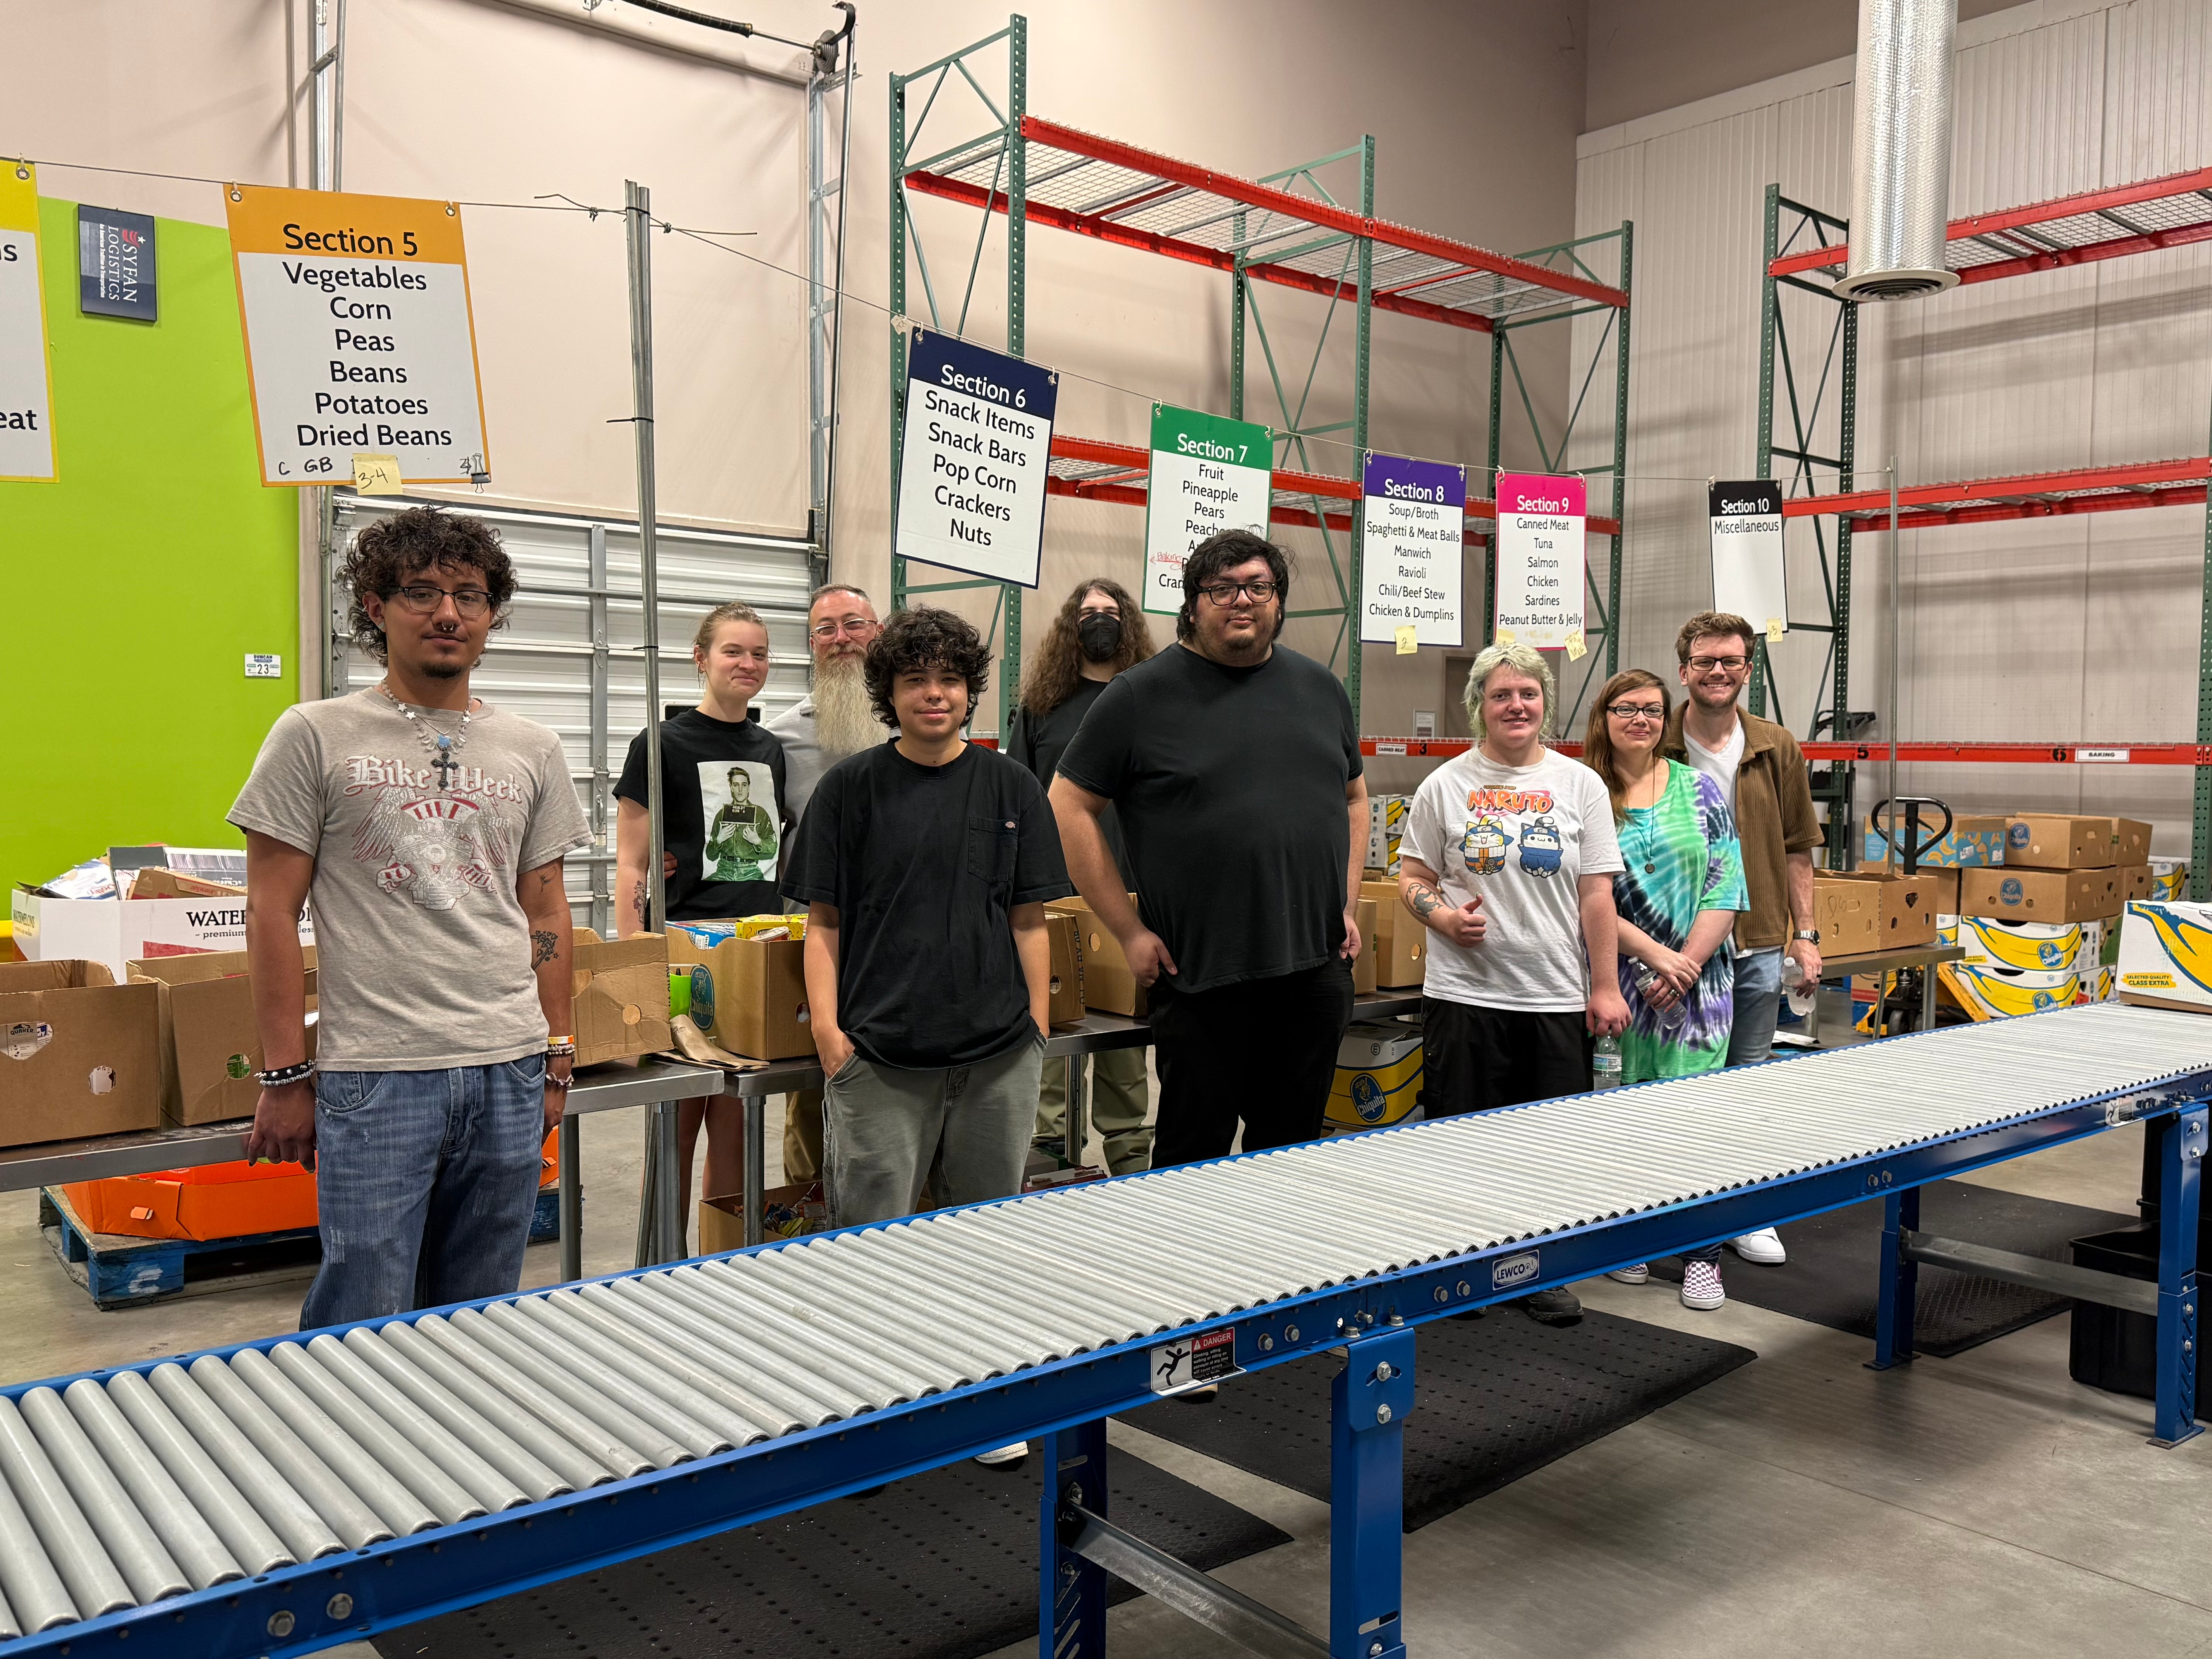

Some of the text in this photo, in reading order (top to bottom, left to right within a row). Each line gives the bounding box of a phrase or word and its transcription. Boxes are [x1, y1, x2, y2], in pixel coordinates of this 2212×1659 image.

[283, 224, 417, 256] Section 5
[108, 225, 119, 301] LOGISTICS
[122, 244, 137, 303] SYFAN
[282, 262, 426, 292] Vegetables
[330, 297, 391, 319] Corn
[335, 329, 394, 351] Peas
[330, 361, 407, 383] Beans
[941, 364, 1025, 407] Section 6
[315, 393, 428, 414] Potatoes
[926, 390, 1034, 439] Snack Items
[297, 423, 451, 446] Dried Beans
[929, 422, 1025, 466] Snack Bars
[1178, 433, 1247, 462] Section 7
[359, 467, 388, 489] 3-4
[934, 453, 1016, 493] Pop Corn
[1199, 464, 1224, 480] Fruit
[1183, 481, 1238, 503] Pineapple
[1385, 479, 1444, 502] Section 8
[935, 485, 1010, 521] Crackers
[1195, 502, 1224, 518] Pears
[1389, 503, 1438, 520] Soup/Broth
[1518, 495, 1568, 512] Section 9
[1722, 498, 1769, 514] Section 10
[951, 519, 991, 545] Nuts
[1367, 521, 1459, 542] Spaghetti & Meat Balls
[1517, 518, 1569, 530] Canned Meat
[1715, 519, 1779, 534] Miscellaneous
[1395, 545, 1431, 559] Manwich
[1534, 538, 1553, 548] Tuna
[1399, 566, 1425, 578] Ravioli
[1528, 556, 1558, 567] Salmon
[1528, 575, 1558, 586] Chicken
[1379, 584, 1444, 599] Chili/Beef Stew
[1525, 595, 1559, 605] Sardines
[1370, 603, 1453, 622] Chicken & Dumplins
[1500, 613, 1582, 627] Peanut Butter & Jelly
[257, 664, 269, 674] 23
[1419, 743, 1427, 755] 3
[1857, 745, 1869, 759] 5
[2053, 746, 2067, 762] 6
[343, 754, 522, 803] Bike Week
[1467, 788, 1554, 815] NARUTO
[690, 997, 713, 1018] Chiquita
[1357, 1094, 1386, 1116] Chiquita
[1496, 1263, 1525, 1281] LEWCO
[1203, 1333, 1231, 1347] DANGER
